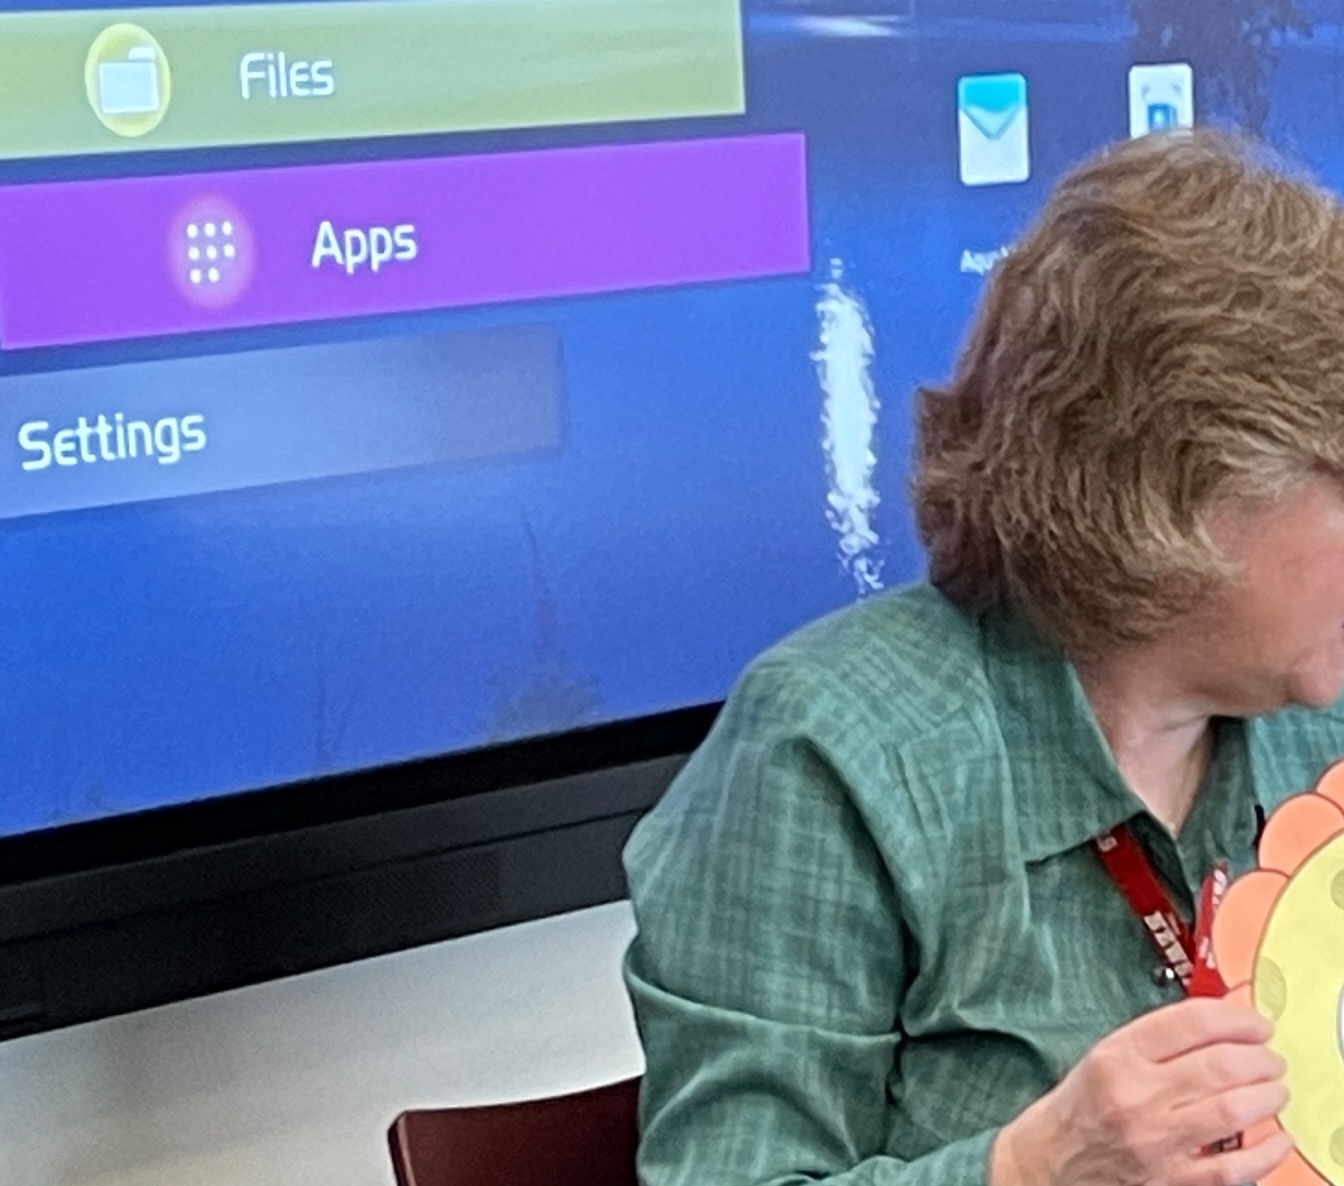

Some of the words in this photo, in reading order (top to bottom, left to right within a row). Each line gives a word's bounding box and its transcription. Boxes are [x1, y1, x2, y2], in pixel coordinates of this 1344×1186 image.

[240, 52, 335, 99] Files
[311, 220, 418, 275] Apps
[18, 411, 207, 471] Settings
